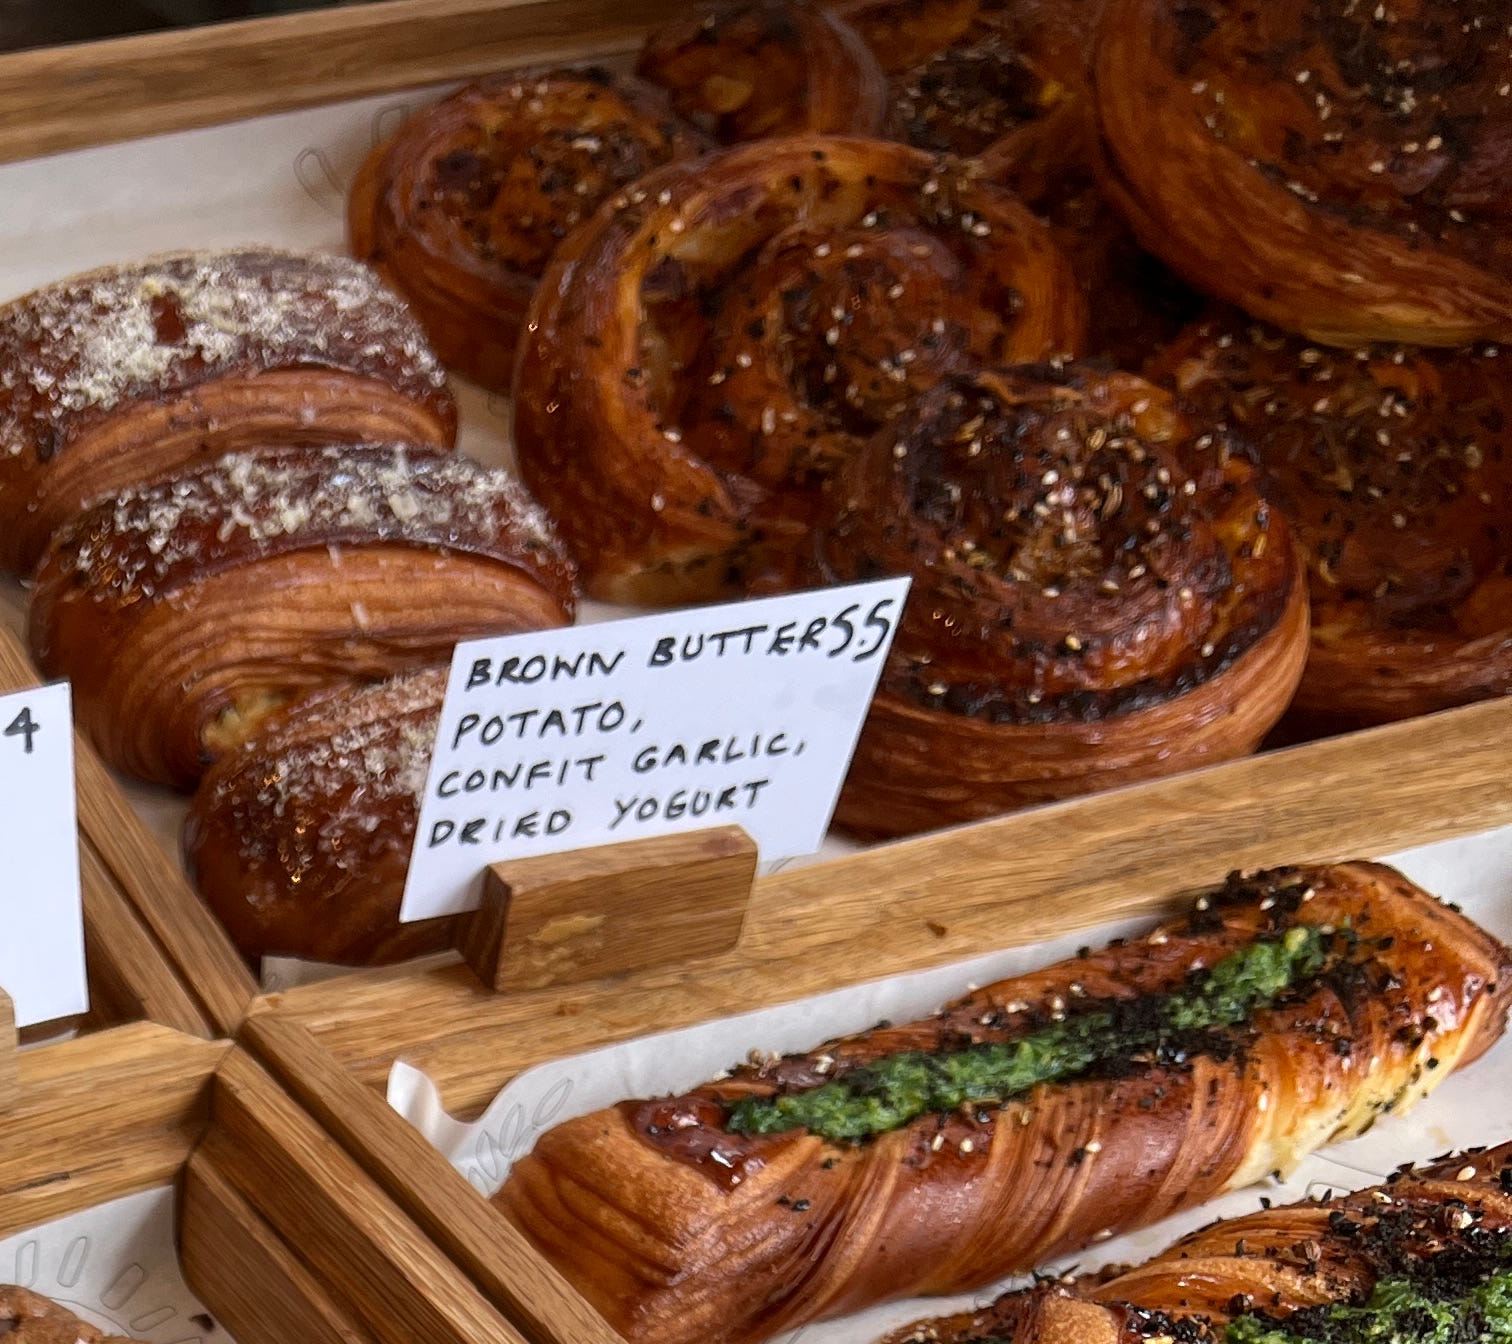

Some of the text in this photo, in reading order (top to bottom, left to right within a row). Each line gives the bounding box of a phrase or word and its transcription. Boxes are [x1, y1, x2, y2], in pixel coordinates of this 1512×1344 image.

[465, 650, 624, 691] BROWN
[648, 617, 827, 667] BUTTER
[2, 706, 41, 753] 4
[451, 701, 644, 750] POTATO,
[436, 733, 805, 799] CONFIT GARLIC,
[428, 779, 769, 848] DRIED YOGURT
